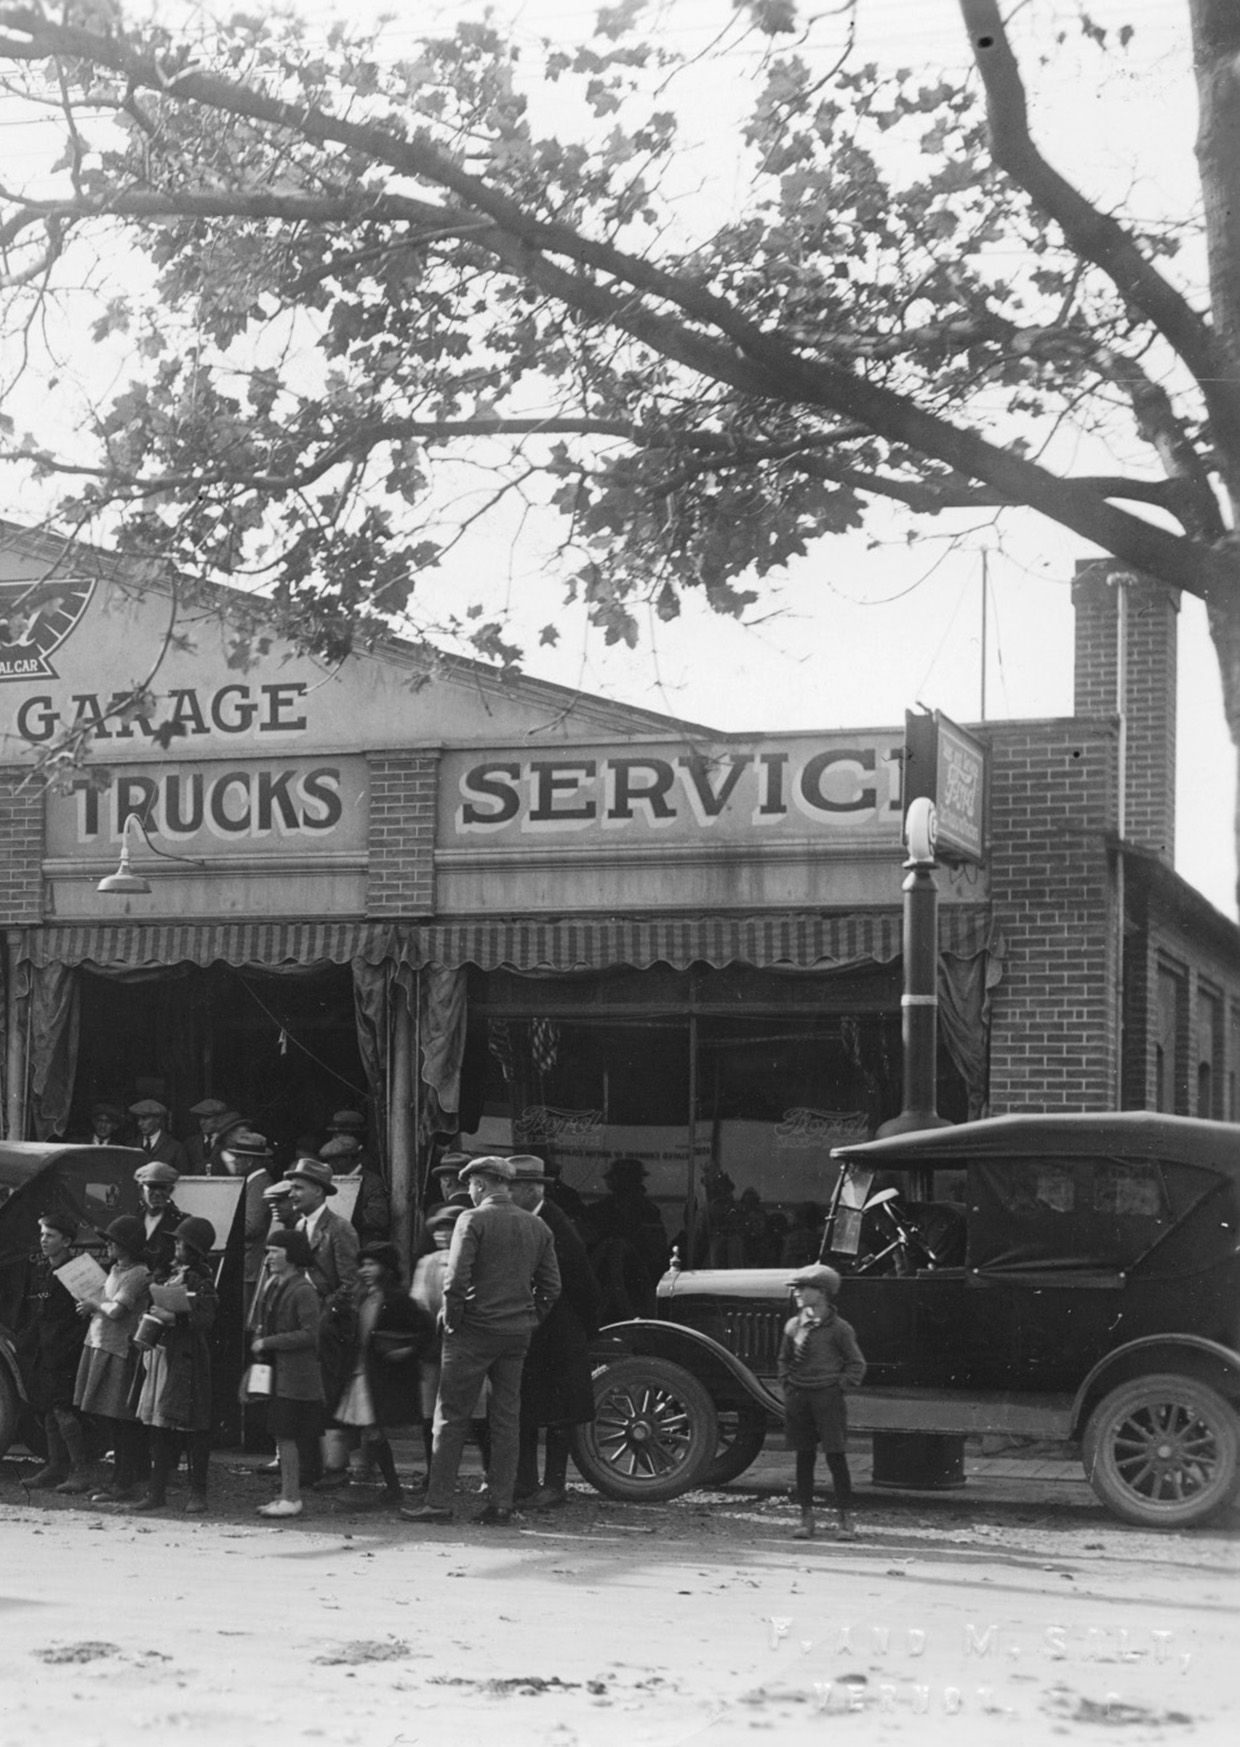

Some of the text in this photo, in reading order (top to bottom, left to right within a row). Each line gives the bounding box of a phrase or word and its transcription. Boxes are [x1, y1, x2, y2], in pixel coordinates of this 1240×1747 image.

[16, 682, 309, 743] GARAGE
[69, 767, 344, 836] TRUCKS
[462, 748, 906, 824] SERVIC
